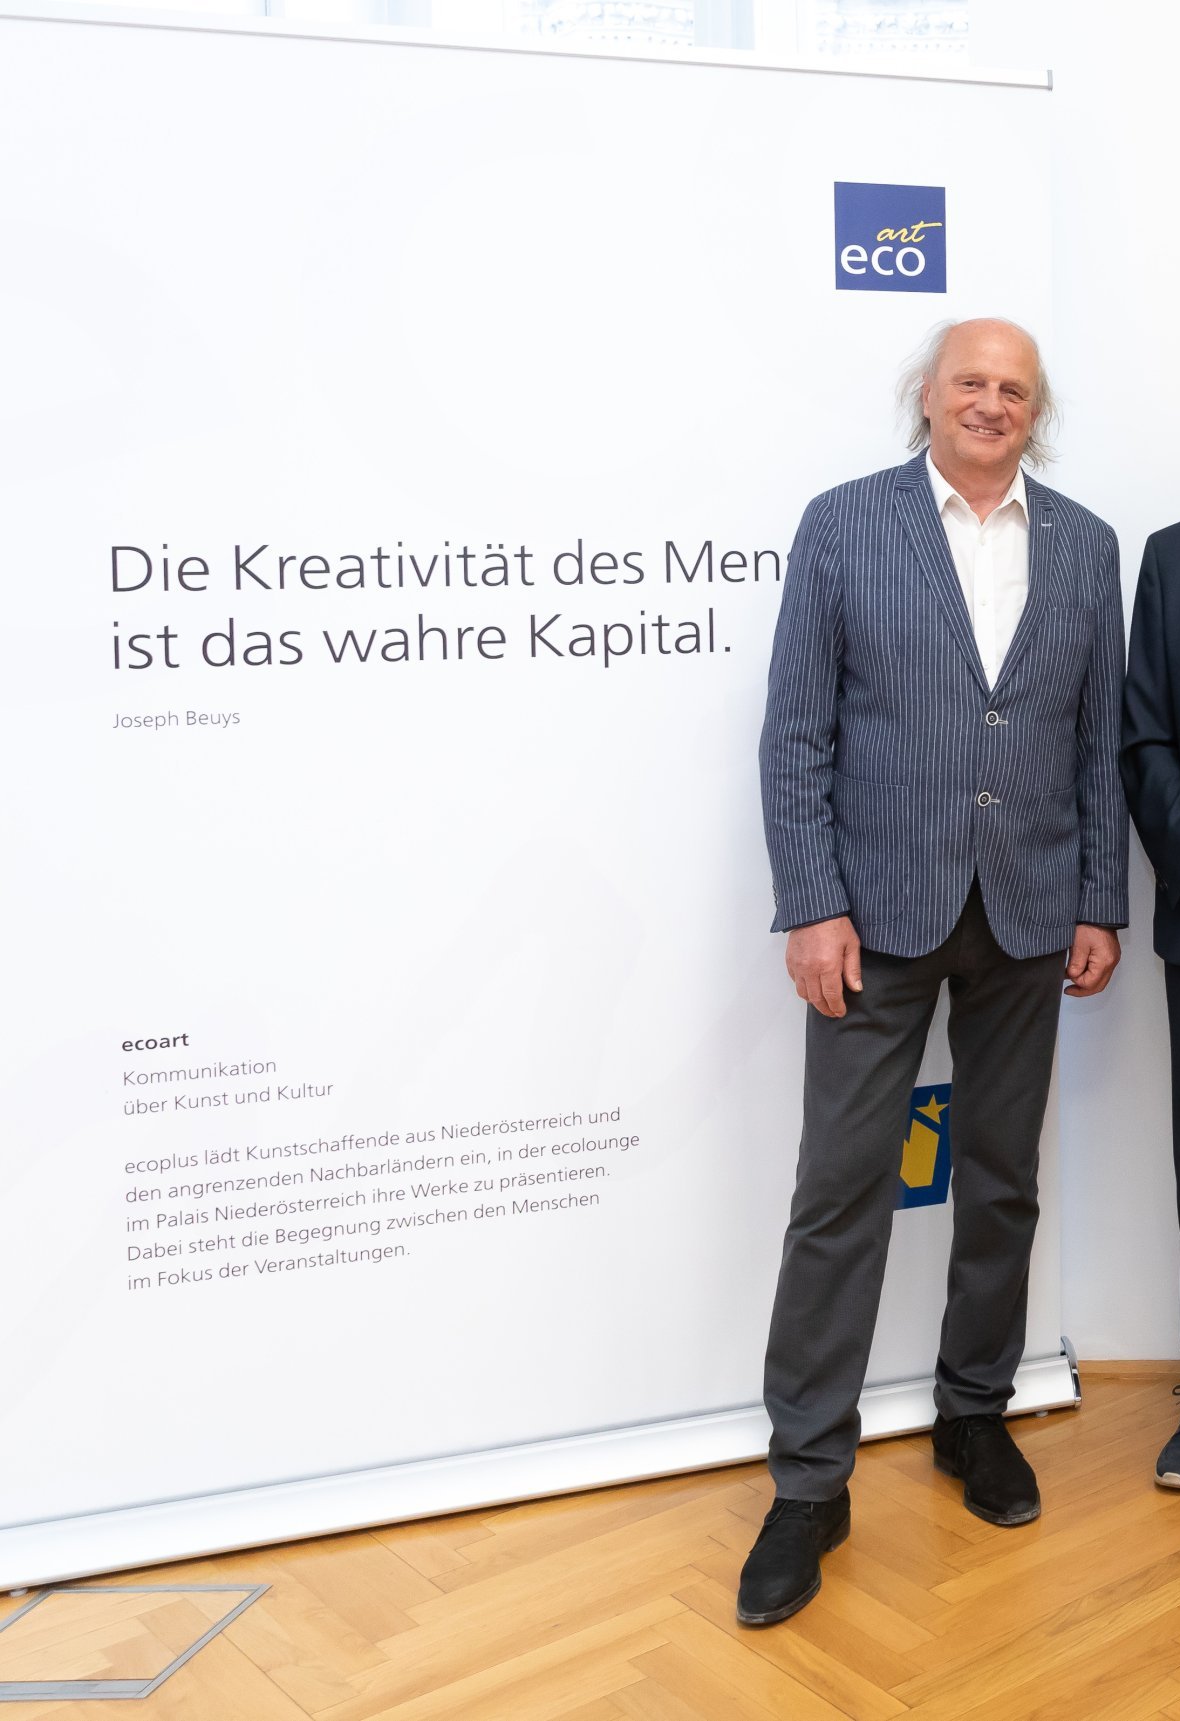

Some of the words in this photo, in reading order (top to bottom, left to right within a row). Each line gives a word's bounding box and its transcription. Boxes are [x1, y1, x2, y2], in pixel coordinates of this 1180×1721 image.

[876, 220, 942, 243] art
[840, 244, 926, 277] eco
[110, 543, 210, 593] Die
[234, 540, 536, 591] Kreativität
[552, 537, 645, 586] des
[664, 539, 791, 585] Men
[112, 620, 181, 670] ist
[201, 616, 304, 668] das
[321, 613, 507, 664] wahre
[529, 606, 731, 669] Kapital.
[112, 709, 179, 732] Joseph
[186, 710, 241, 729] Beuys
[121, 1032, 190, 1053] ecoart
[123, 1059, 277, 1087] Kommunikation
[123, 1098, 168, 1116] über
[174, 1091, 230, 1111] Kunst
[234, 1085, 271, 1105] und
[277, 1082, 334, 1101] Kultur
[124, 1152, 199, 1175] ecoplus
[204, 1146, 241, 1166] lädt
[246, 1130, 400, 1161] Kunstschaffende
[405, 1129, 436, 1144] aus
[441, 1111, 583, 1140] Niederösterreich
[588, 1105, 621, 1125] und
[125, 1186, 162, 1204] den
[167, 1170, 304, 1200] angrenzenden
[310, 1154, 455, 1183] Nachbarländern
[460, 1149, 492, 1166] ein,
[497, 1146, 513, 1162] in
[518, 1143, 547, 1160] der
[551, 1135, 640, 1156] ecolounge
[126, 1216, 150, 1233] im
[156, 1210, 209, 1230] Palais
[215, 1190, 366, 1222] Niederösterreich
[372, 1187, 406, 1204] ihre
[410, 1179, 469, 1199] Werke
[473, 1179, 494, 1192] zu
[499, 1166, 611, 1193] präsentieren.
[127, 1239, 183, 1262] Dabei
[188, 1234, 237, 1254] steht
[241, 1230, 270, 1248] die
[275, 1220, 381, 1245] Begegnung
[386, 1208, 468, 1231] zwischen
[473, 1203, 506, 1219] den
[512, 1192, 600, 1215] Menschen
[127, 1274, 151, 1291] im
[157, 1267, 213, 1287] Fokus
[218, 1261, 250, 1279] der
[253, 1245, 411, 1275] Veranstaltungen.
